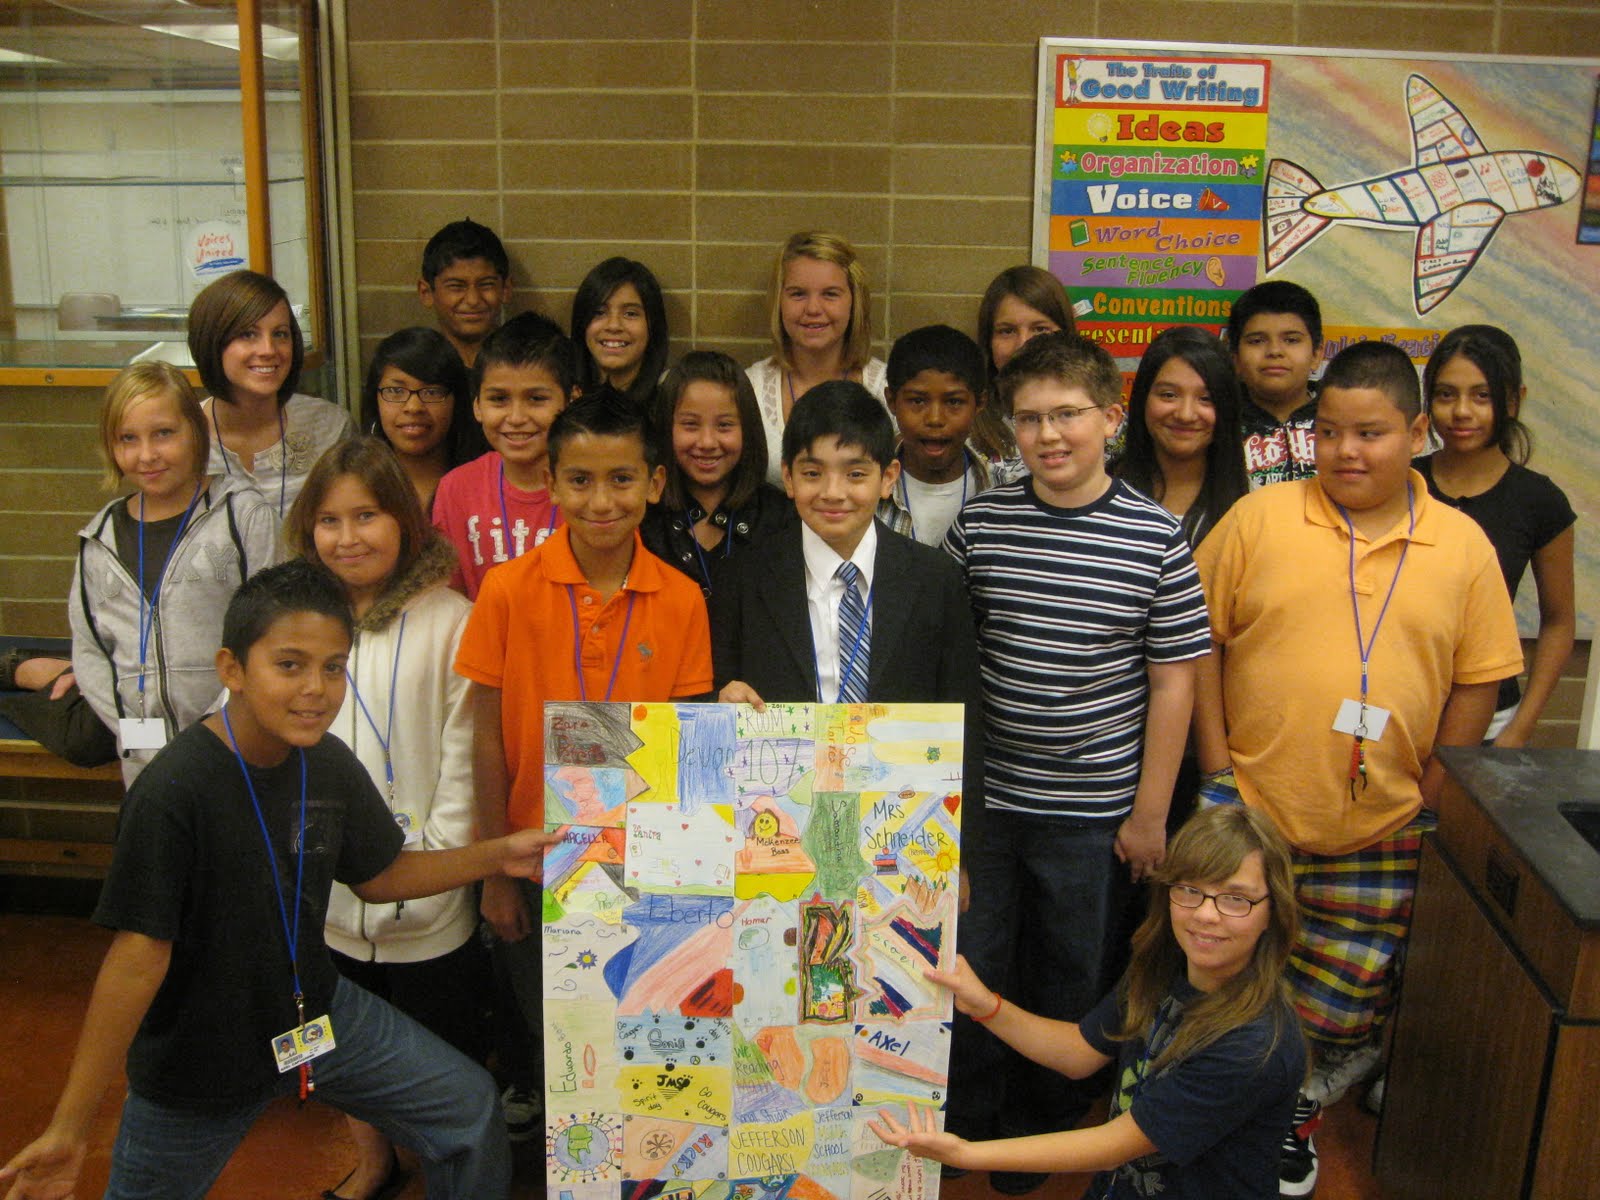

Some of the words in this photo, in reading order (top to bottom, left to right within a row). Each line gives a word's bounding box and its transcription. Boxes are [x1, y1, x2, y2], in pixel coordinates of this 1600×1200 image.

[1107, 62, 1137, 78] The
[1142, 63, 1192, 79] Traits
[1197, 64, 1217, 79] of
[1081, 78, 1149, 99] Good
[1160, 80, 1259, 107] Writing
[1117, 114, 1225, 143] Ideas
[1081, 152, 1238, 177] Organization
[1087, 184, 1192, 214] Voice
[1095, 220, 1161, 243] Word
[1155, 232, 1241, 251] Choice
[1081, 254, 1175, 276] Sentence
[1126, 259, 1204, 287] Fluency
[1093, 292, 1231, 317] Conventions
[745, 707, 785, 736] ROOM
[744, 738, 801, 789] 107
[544, 925, 582, 935] Mariana
[633, 1094, 657, 1107] Spirit
[699, 1087, 713, 1098] Go
[648, 1102, 662, 1111] day
[697, 1100, 727, 1122] Cougars
[731, 1128, 805, 1150] JEFFERSON
